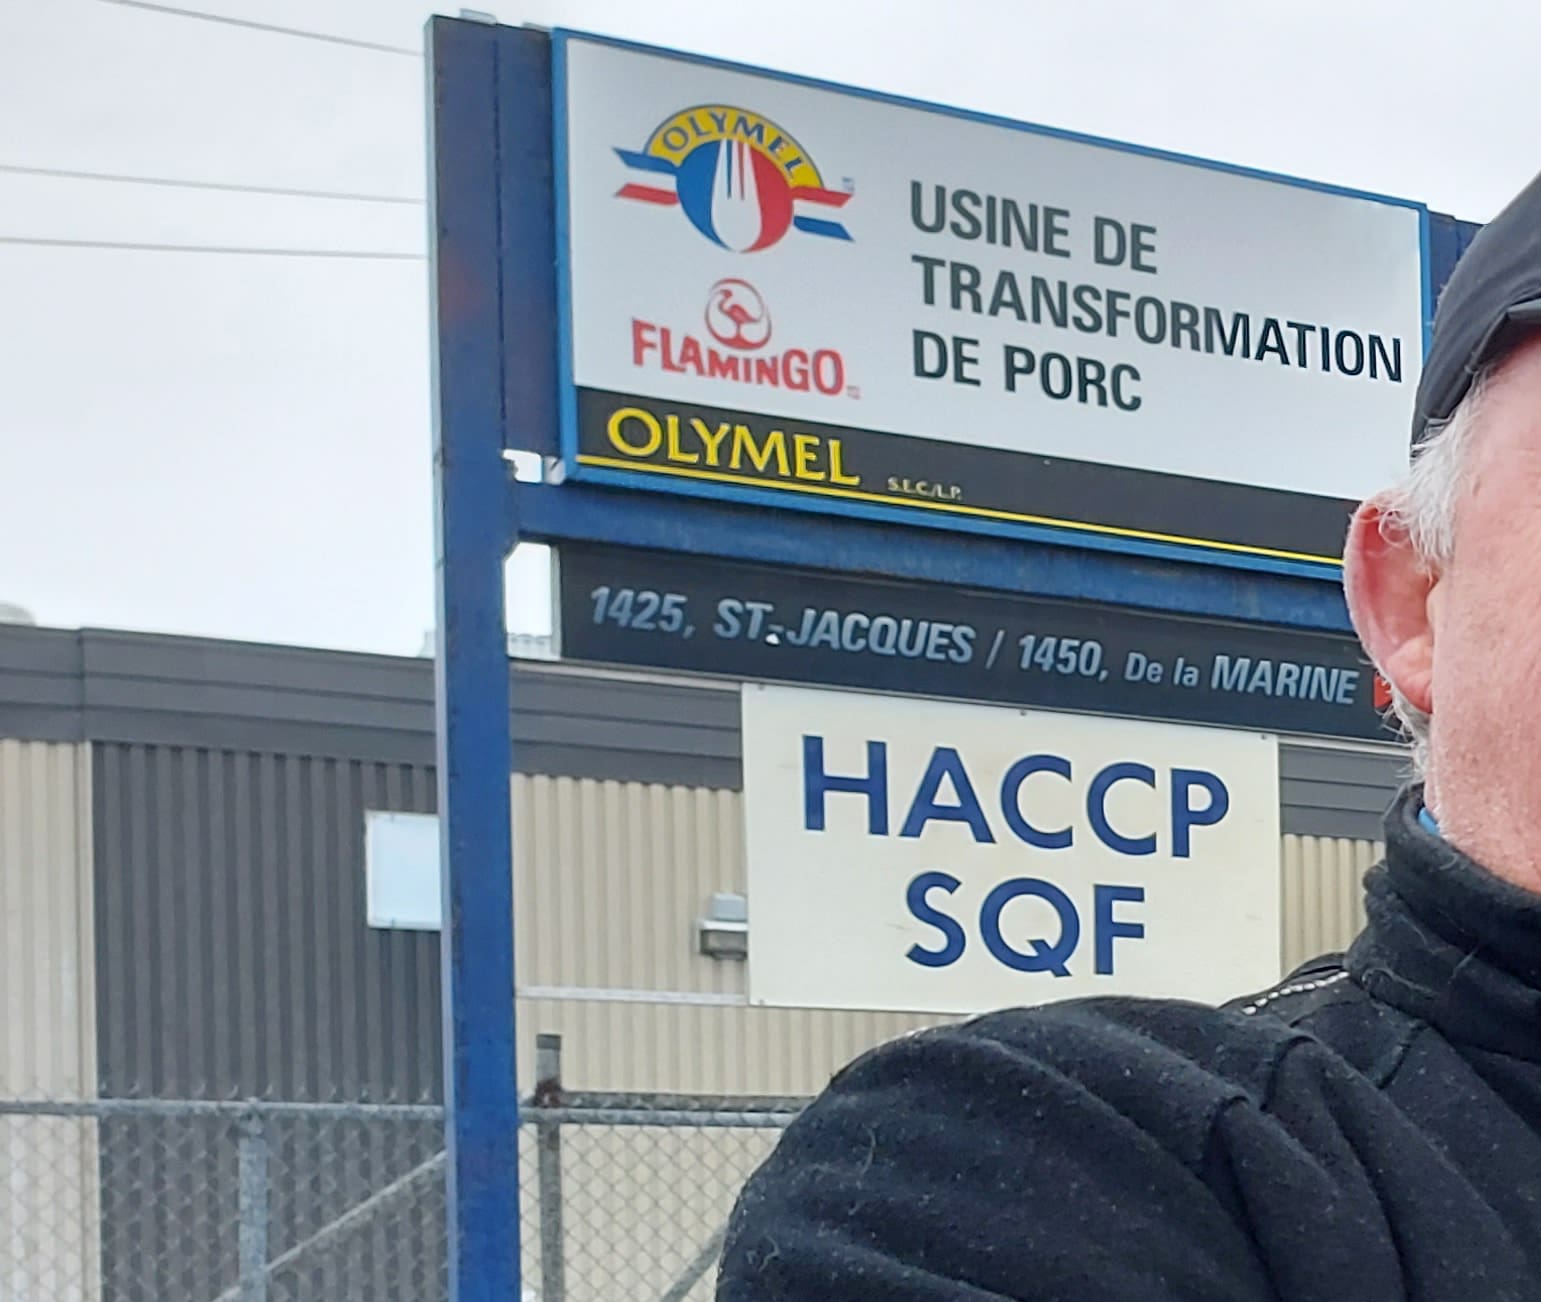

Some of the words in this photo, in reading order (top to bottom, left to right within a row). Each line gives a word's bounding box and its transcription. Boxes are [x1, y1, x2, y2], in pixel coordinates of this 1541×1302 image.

[663, 110, 804, 180] OLYMEL
[911, 180, 1070, 258] USINE
[1094, 216, 1157, 274] DE
[631, 317, 845, 396] FLAMINGO
[912, 254, 1402, 384] TRANSFORMATION
[912, 329, 981, 387] DE
[1004, 344, 1142, 412] PORC
[607, 407, 861, 486] OLYMEL
[590, 586, 695, 639] 1425,
[986, 630, 1005, 669] /
[1018, 634, 1109, 682] 1450,
[1124, 652, 1162, 684] De
[1173, 657, 1200, 688] la
[1211, 655, 1360, 705] MARINE
[802, 733, 1229, 859] HACCP
[905, 870, 1145, 978] SQF
